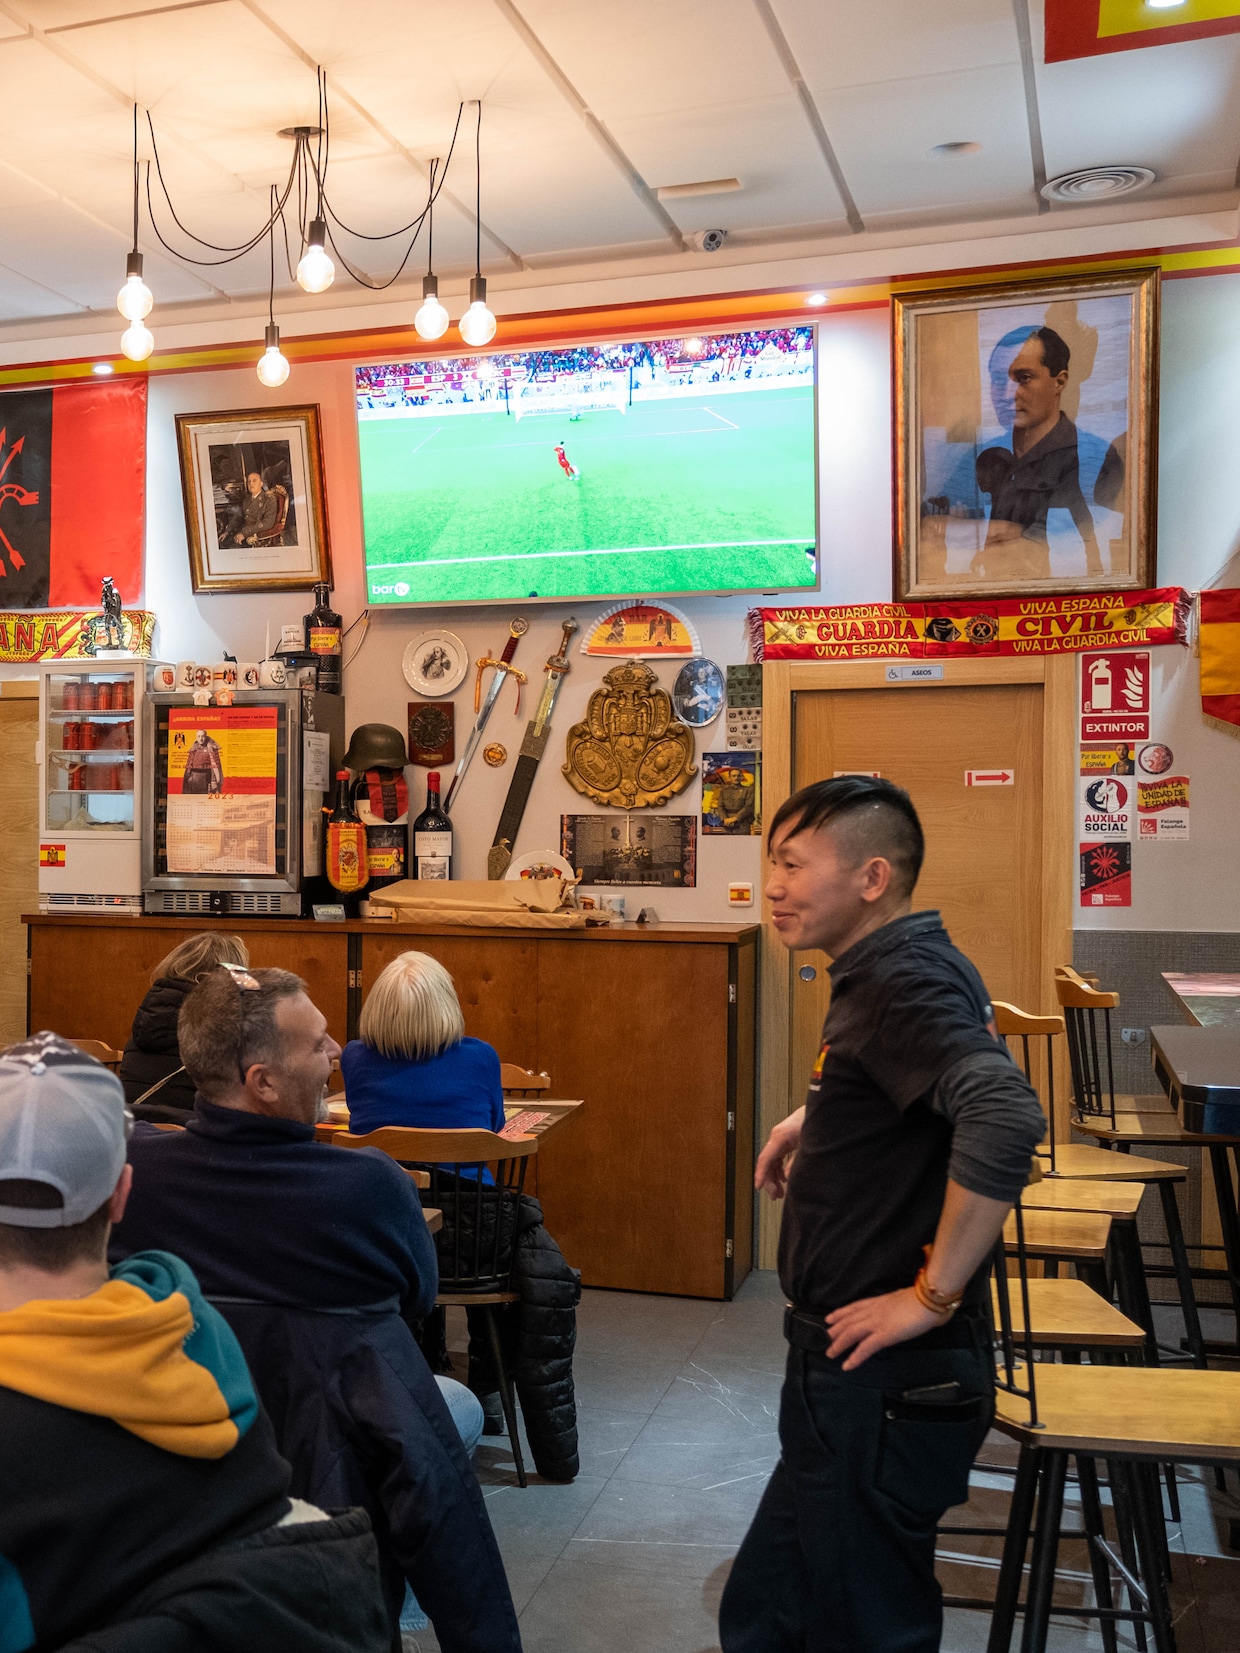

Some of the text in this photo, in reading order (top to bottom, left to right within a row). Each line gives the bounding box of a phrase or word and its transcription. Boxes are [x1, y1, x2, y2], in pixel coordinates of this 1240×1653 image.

[1019, 595, 1125, 614] VIVA ESPAÑA
[775, 605, 911, 621] VIVA LA GUARDIA CIVIL
[817, 611, 1114, 641] GUARDIA CIVIL
[1013, 629, 1151, 653] VIVA LA GUARDIA CIVIL
[815, 642, 910, 657] VIVA ESPAÑA
[1085, 722, 1145, 733] EXTINTOR
[1171, 780, 1183, 788] LA
[1142, 788, 1186, 800] UNIDAD DE
[1084, 814, 1128, 823] AUXILIO
[1084, 823, 1128, 832] SOCIAL
